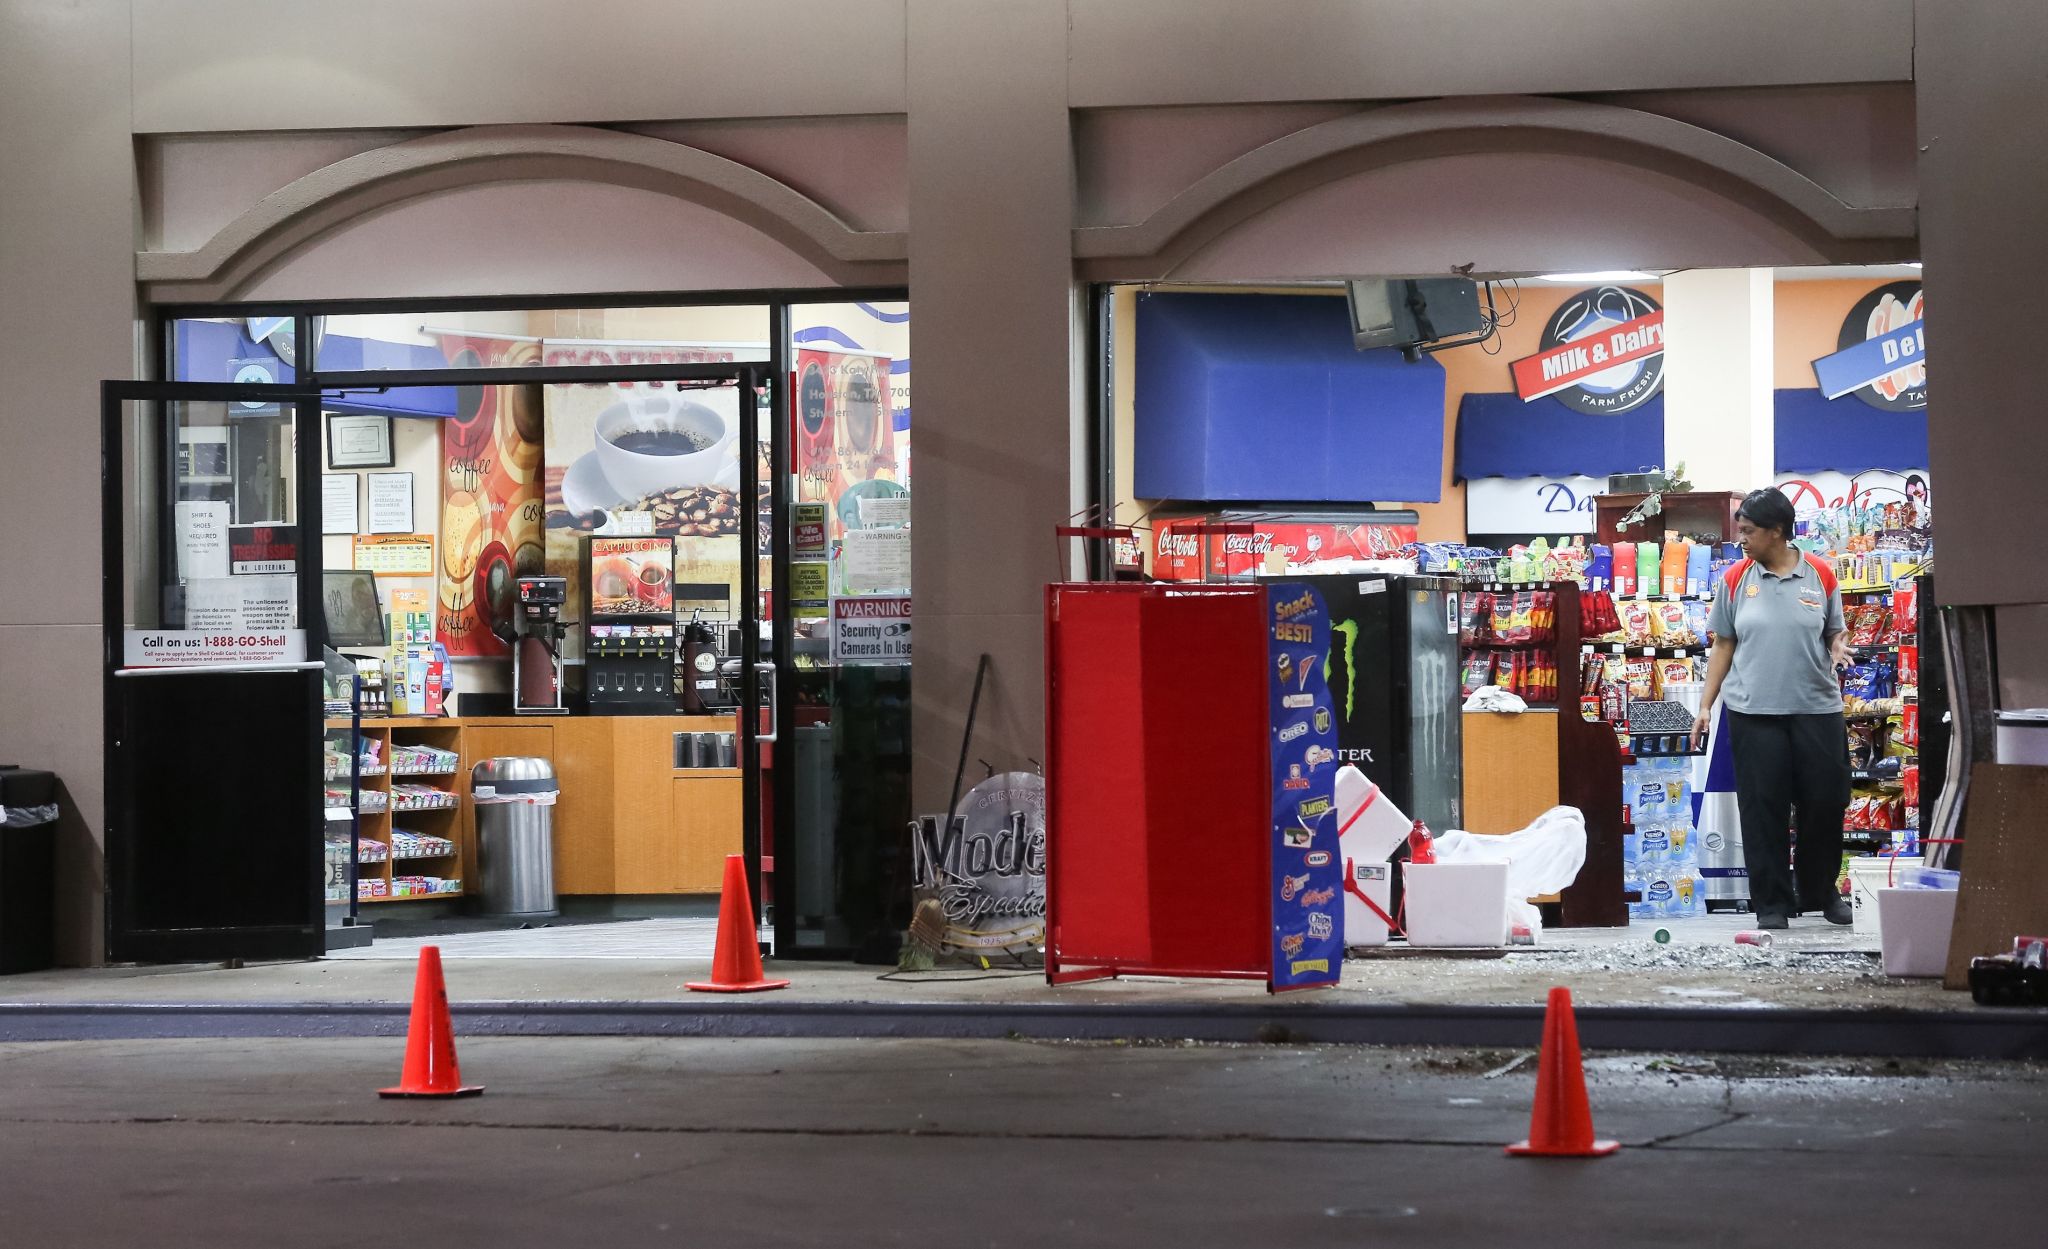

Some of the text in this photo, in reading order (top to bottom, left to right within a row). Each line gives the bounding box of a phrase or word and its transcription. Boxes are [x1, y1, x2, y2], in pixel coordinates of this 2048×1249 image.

[1541, 321, 1664, 382] Milk & Dairy
[1881, 327, 1925, 365] Del
[1581, 370, 1653, 406] FARM FRESH
[1536, 483, 1603, 512] Da
[253, 528, 273, 543] NO
[796, 533, 823, 544] Card
[801, 526, 819, 535] We
[593, 541, 672, 552] CAPPUCCINO
[1223, 532, 1274, 554] Coca-Cola
[232, 544, 296, 561] TRESPASSING
[839, 602, 911, 617] WARNING
[1275, 590, 1315, 620] Snack
[438, 592, 473, 651] coffee
[841, 624, 881, 640] Security
[1275, 622, 1312, 643] BEST!
[142, 636, 286, 647] Call on us: 1-888-GO-Shell
[841, 641, 911, 655] Cameras In Use
[1844, 679, 1870, 688] Doritos
[1315, 711, 1329, 731] RITZ
[1279, 722, 1308, 742] OREO
[1337, 748, 1374, 763] TER
[1301, 799, 1329, 816] PLANTERS
[908, 810, 1045, 890] Mode
[1308, 912, 1331, 926] Chips
[1281, 933, 1304, 950] Chex
[1310, 926, 1332, 940] Ahoy!
